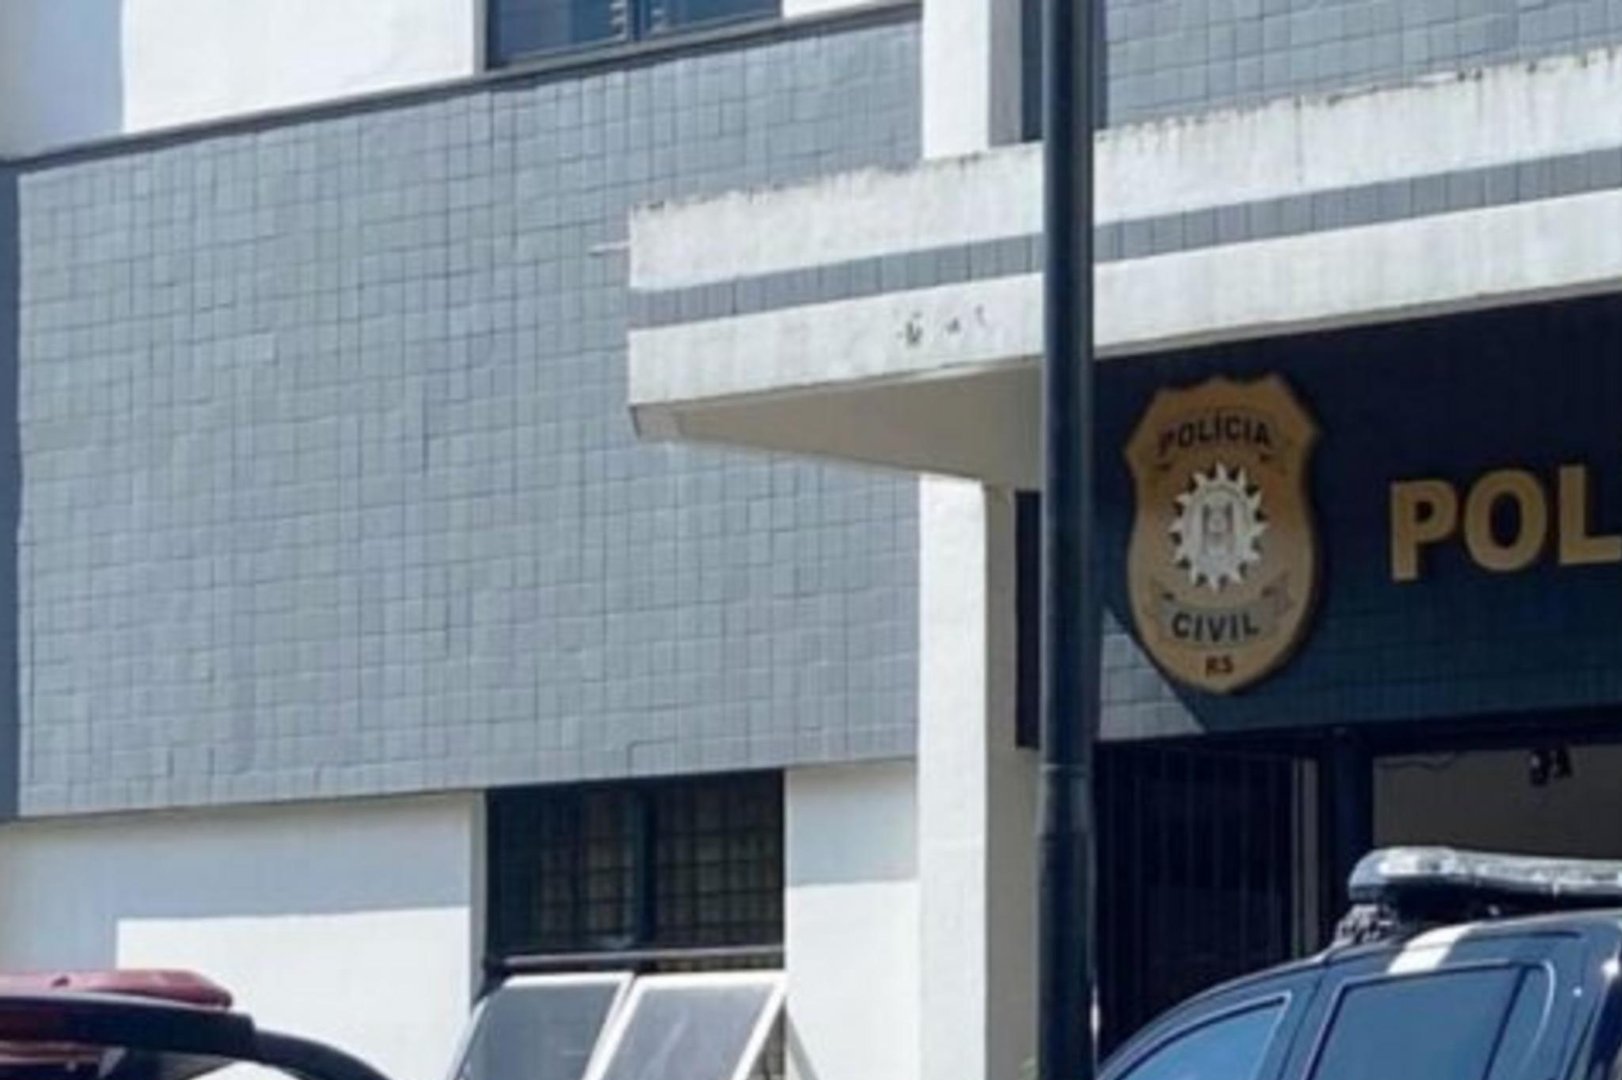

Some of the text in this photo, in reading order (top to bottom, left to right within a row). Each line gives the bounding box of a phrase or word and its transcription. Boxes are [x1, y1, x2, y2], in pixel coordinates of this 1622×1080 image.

[1157, 412, 1271, 457] POLÍCIA
[1171, 610, 1261, 643] CIVIL
[1204, 654, 1235, 679] RS
